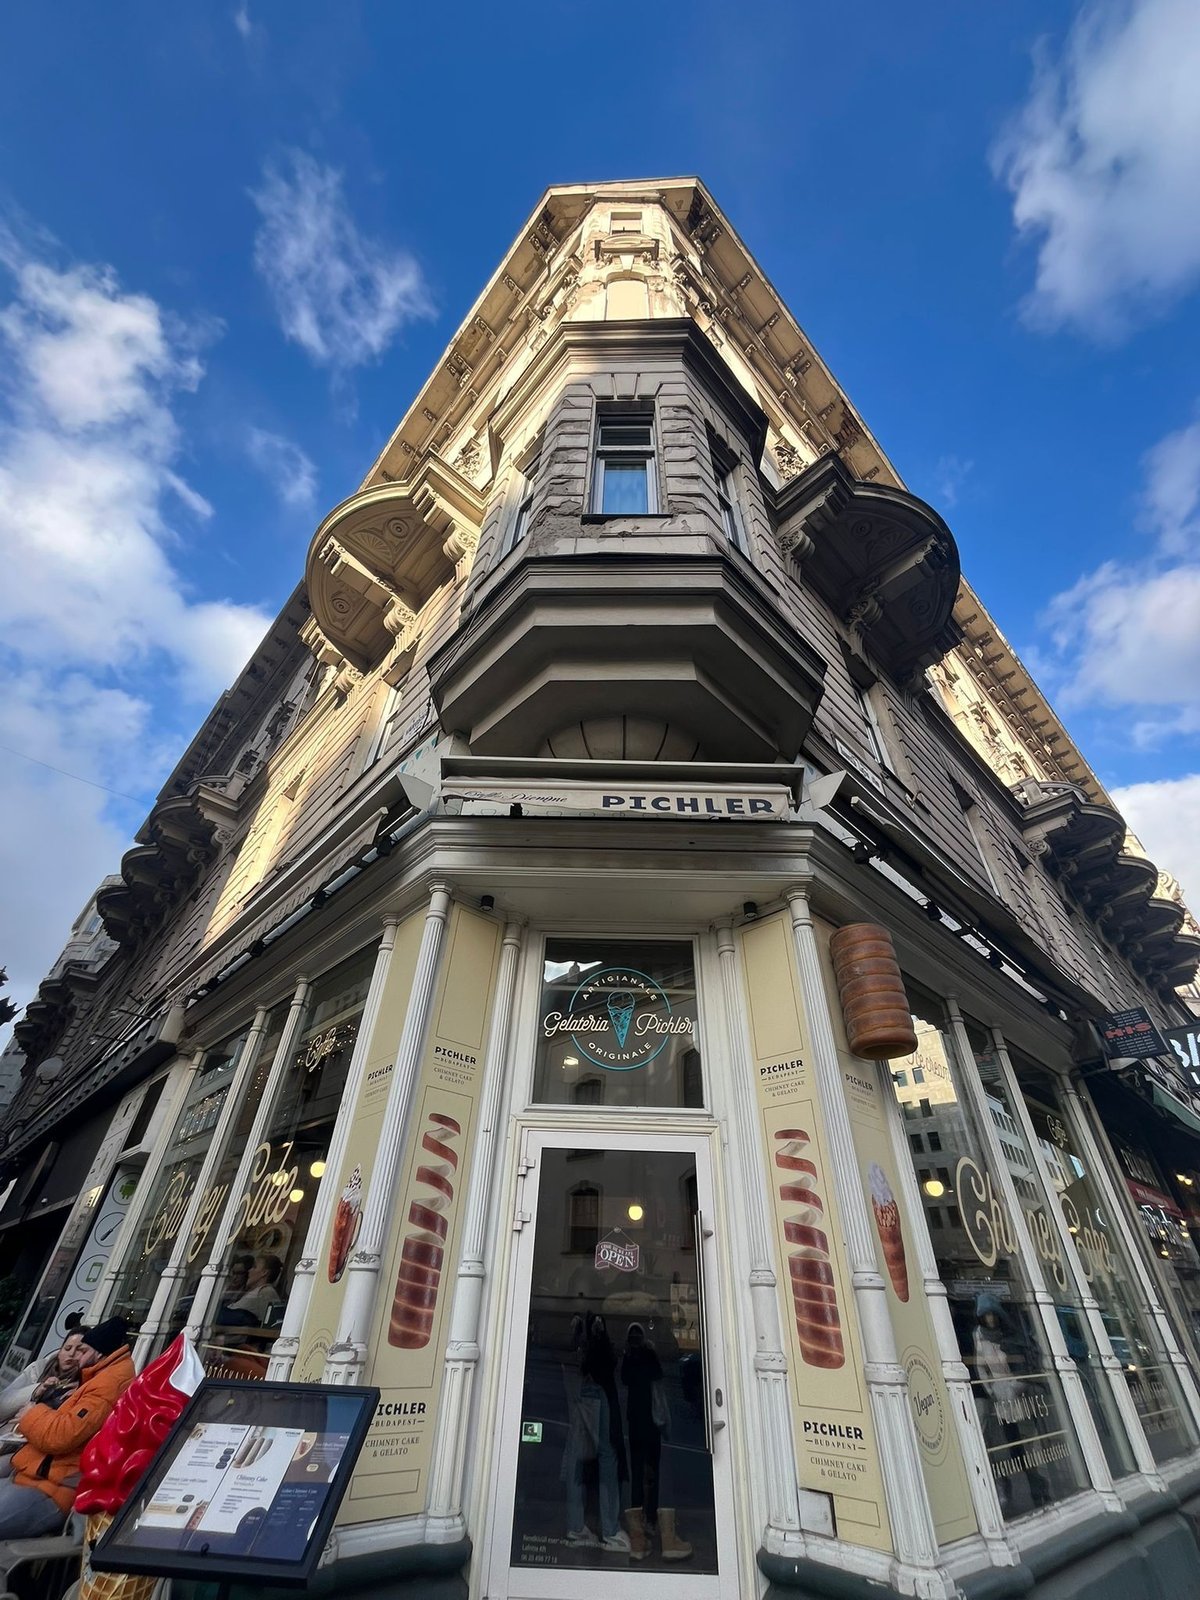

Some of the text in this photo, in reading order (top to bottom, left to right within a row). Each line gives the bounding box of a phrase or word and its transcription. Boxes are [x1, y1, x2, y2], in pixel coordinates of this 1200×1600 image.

[602, 794, 775, 816] PICHLER
[582, 975, 657, 1001] ARTIGIANALE
[543, 1011, 694, 1037] Gelateria Pichler
[434, 1046, 477, 1065] PICHLER
[588, 1041, 652, 1060] ORIGINALE
[367, 1064, 394, 1080] PICHLER
[760, 1059, 804, 1076] PICHLER
[764, 1080, 805, 1093] CHIMNEY CAKE
[845, 1073, 874, 1092] PICHLER
[776, 1088, 798, 1096] GELATO
[600, 1248, 634, 1267] OPEN
[377, 1402, 426, 1416] ICHLER
[913, 1391, 935, 1416] Vegan
[375, 1418, 417, 1428] BUDAPEST
[803, 1420, 864, 1440] PICHLER
[365, 1436, 420, 1448] CHIMNEY CAKE
[814, 1438, 856, 1451] BUDAPEST
[380, 1447, 408, 1456] GELATO
[810, 1456, 867, 1472] CHIMNEY CAKE
[821, 1468, 857, 1481] & GELATO
